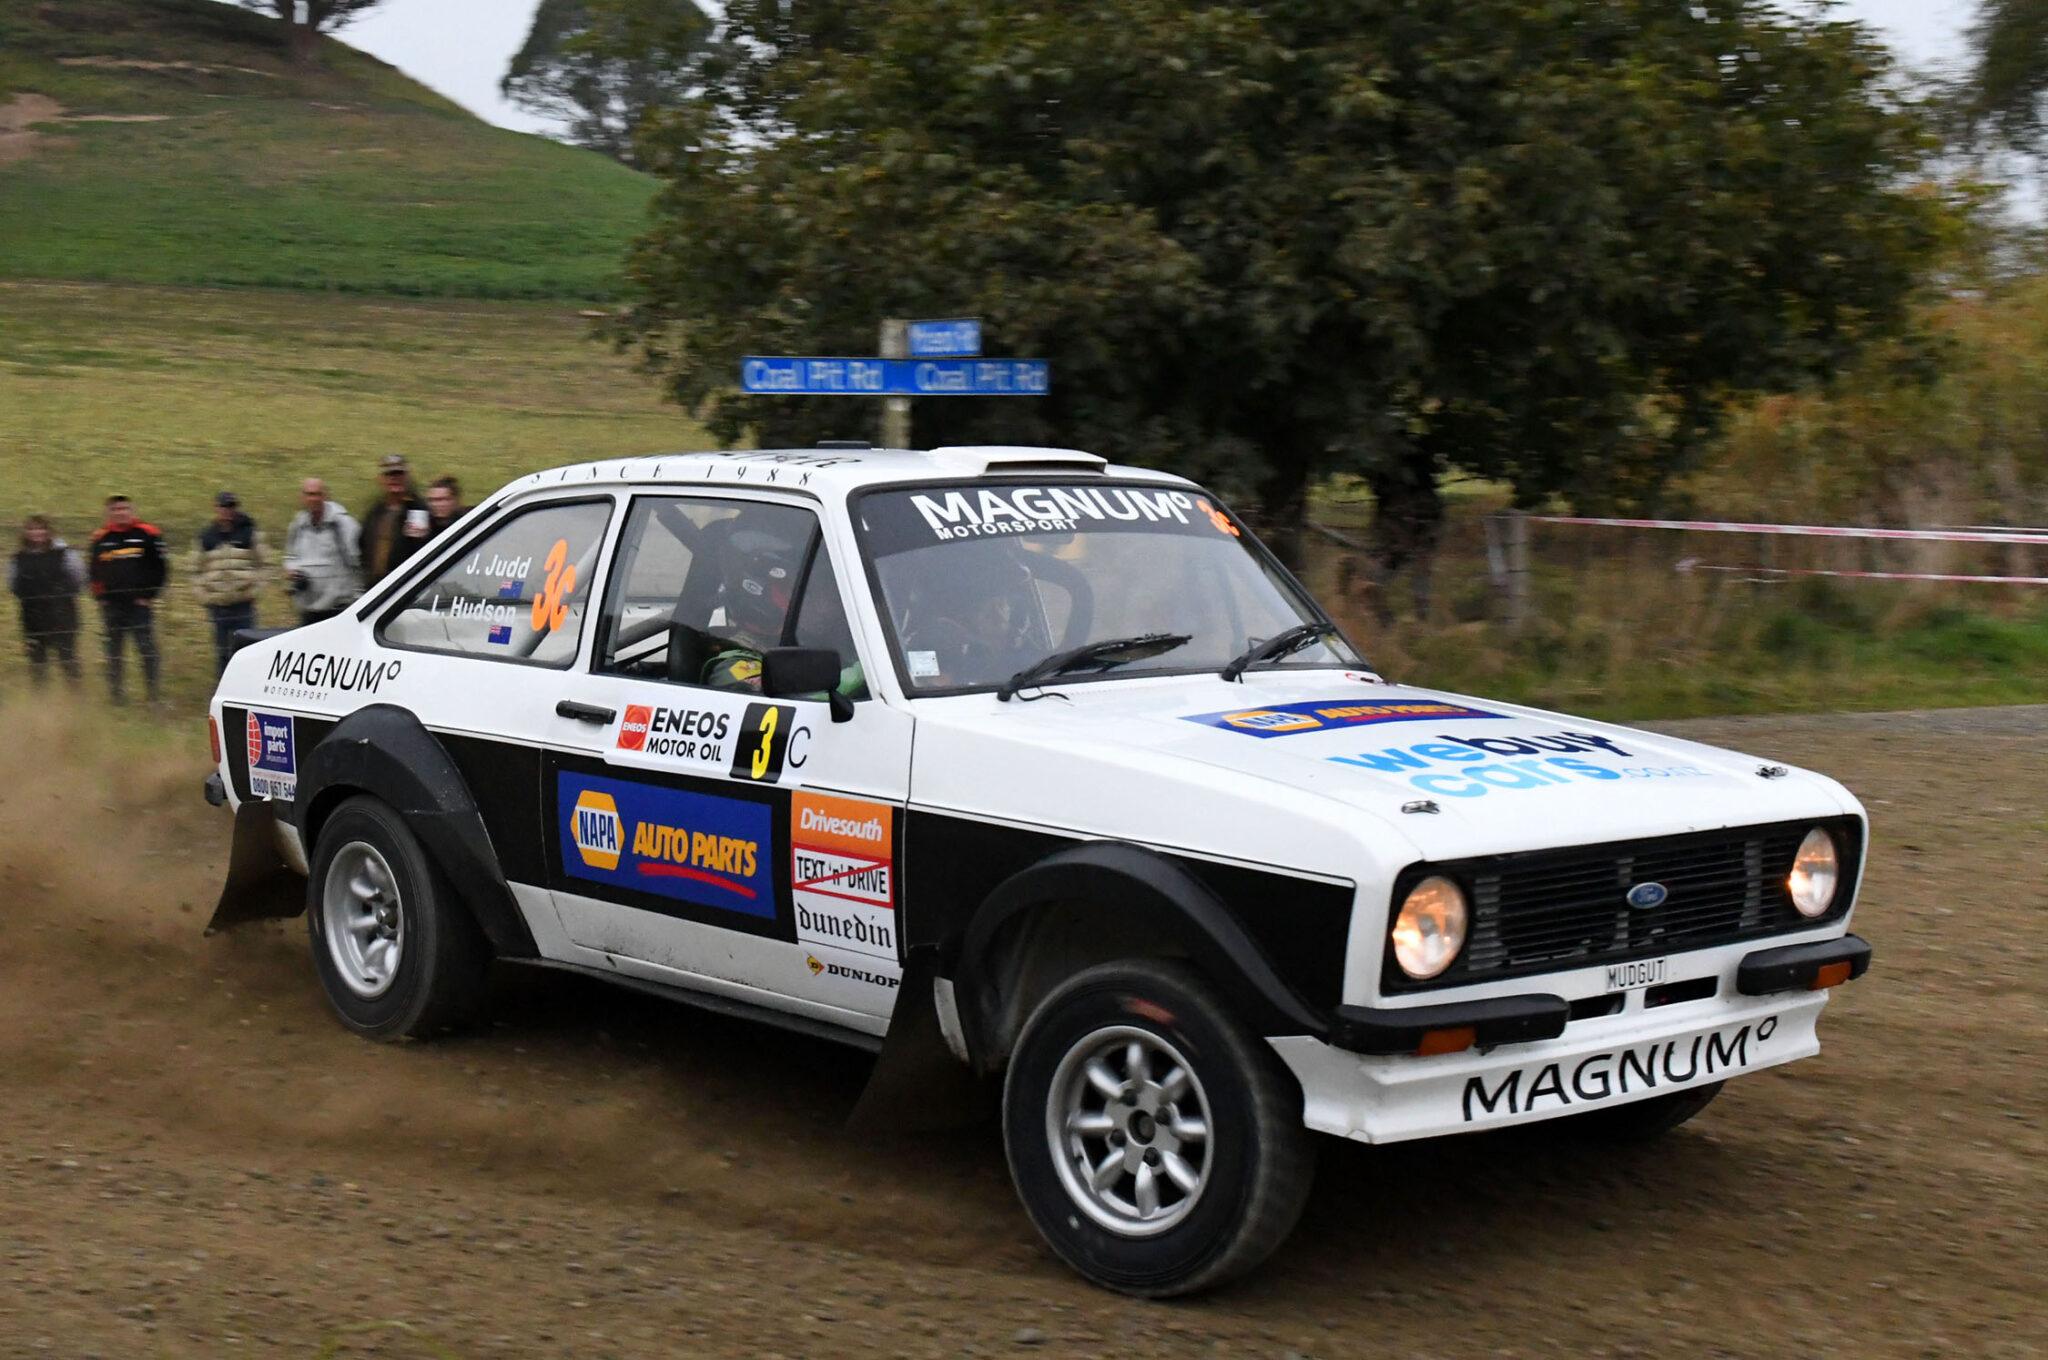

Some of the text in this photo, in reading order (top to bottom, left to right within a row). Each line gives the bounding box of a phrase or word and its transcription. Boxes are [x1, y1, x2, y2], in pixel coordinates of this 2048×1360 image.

[706, 465, 812, 486] 1988
[935, 518, 1078, 540] MOTORSPORT
[466, 553, 532, 579] J. Judd
[430, 595, 516, 623] L. Hudson
[264, 684, 328, 700] MOTORSPORT
[264, 721, 288, 739] import
[622, 721, 647, 734] ENEOS
[651, 707, 730, 740] ENEOS
[267, 740, 286, 754] parts
[646, 737, 721, 762] MOTOR OIL
[751, 706, 779, 780] 3
[578, 810, 618, 851] NAPA
[800, 807, 883, 842] Drivesouth
[633, 821, 758, 878] AUTO PARTS
[797, 856, 825, 880] TEXT
[848, 866, 887, 894] DRIVE
[798, 902, 892, 949] dunedin
[827, 963, 899, 989] DUNLOP
[1607, 960, 1664, 989] MUDGUT
